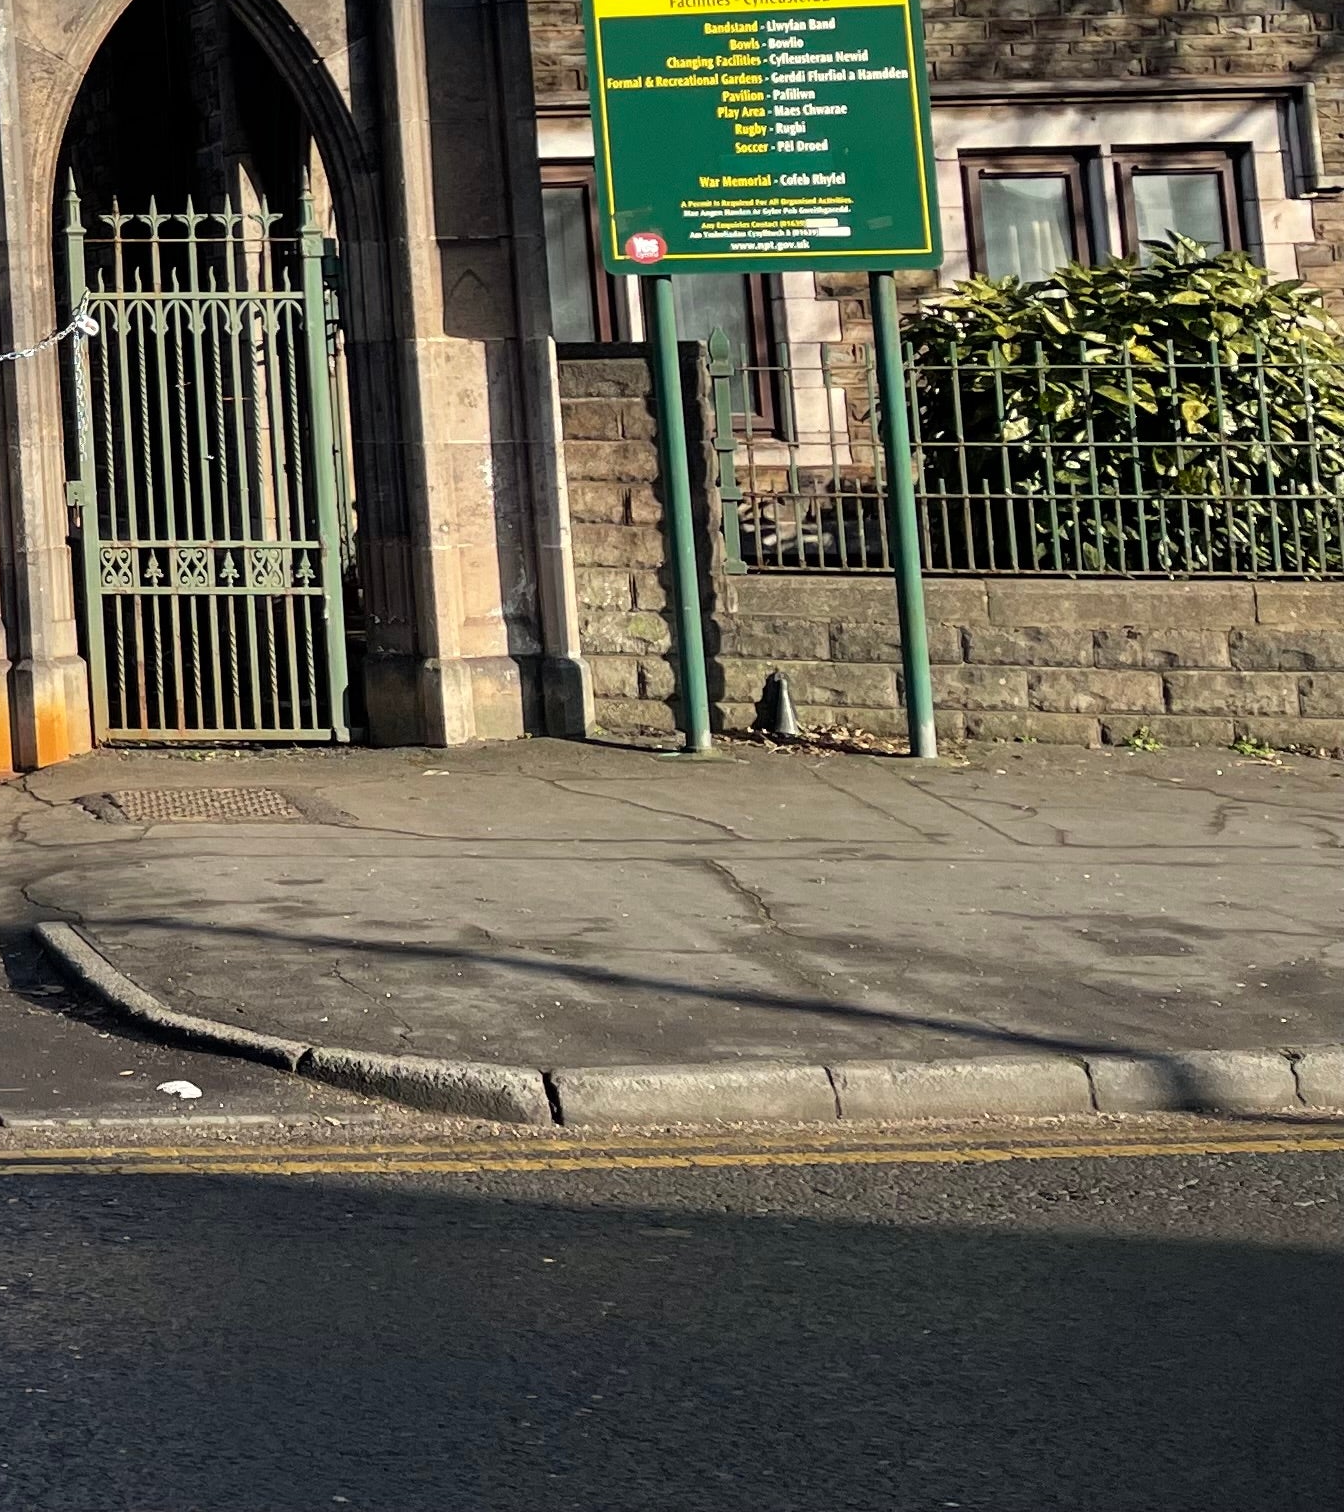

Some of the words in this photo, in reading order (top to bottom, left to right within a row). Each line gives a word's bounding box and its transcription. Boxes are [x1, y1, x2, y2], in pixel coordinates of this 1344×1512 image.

[704, 20, 758, 35] Bandstand
[767, 19, 807, 35] Llwyfan
[808, 17, 836, 31] Band
[729, 38, 760, 51] Bowls
[768, 37, 804, 50] Bowlio
[666, 55, 714, 70] Changing
[716, 53, 762, 67] Facilities
[769, 52, 834, 67] Cyfleusterau
[835, 49, 869, 63] Newid
[607, 75, 642, 89] Formal
[645, 76, 654, 88] &
[655, 73, 719, 88] Recreational
[721, 72, 763, 86] Gardens
[771, 69, 806, 84] Gerddi
[808, 69, 847, 83] Ffurfiol
[848, 72, 856, 82] a
[858, 67, 909, 81] Hamdden
[722, 89, 764, 103] Pavilion
[772, 88, 816, 101] Pafiliwn
[717, 106, 739, 120] Play
[741, 106, 766, 118] Area
[774, 105, 801, 117] Maes
[803, 103, 848, 116] Chwarae
[734, 122, 767, 137] Rugby
[775, 121, 806, 136] Rugbi
[735, 141, 768, 154] Soccer
[796, 138, 829, 152] Droed
[699, 176, 719, 188] War
[722, 174, 772, 187] Memorial
[780, 173, 810, 186] Cofeb
[812, 172, 846, 187] Rhyfel
[721, 199, 754, 208] Required
[701, 222, 715, 230] Any
[633, 237, 659, 253] Yes
[730, 239, 810, 251] www.npt.gov.uk
